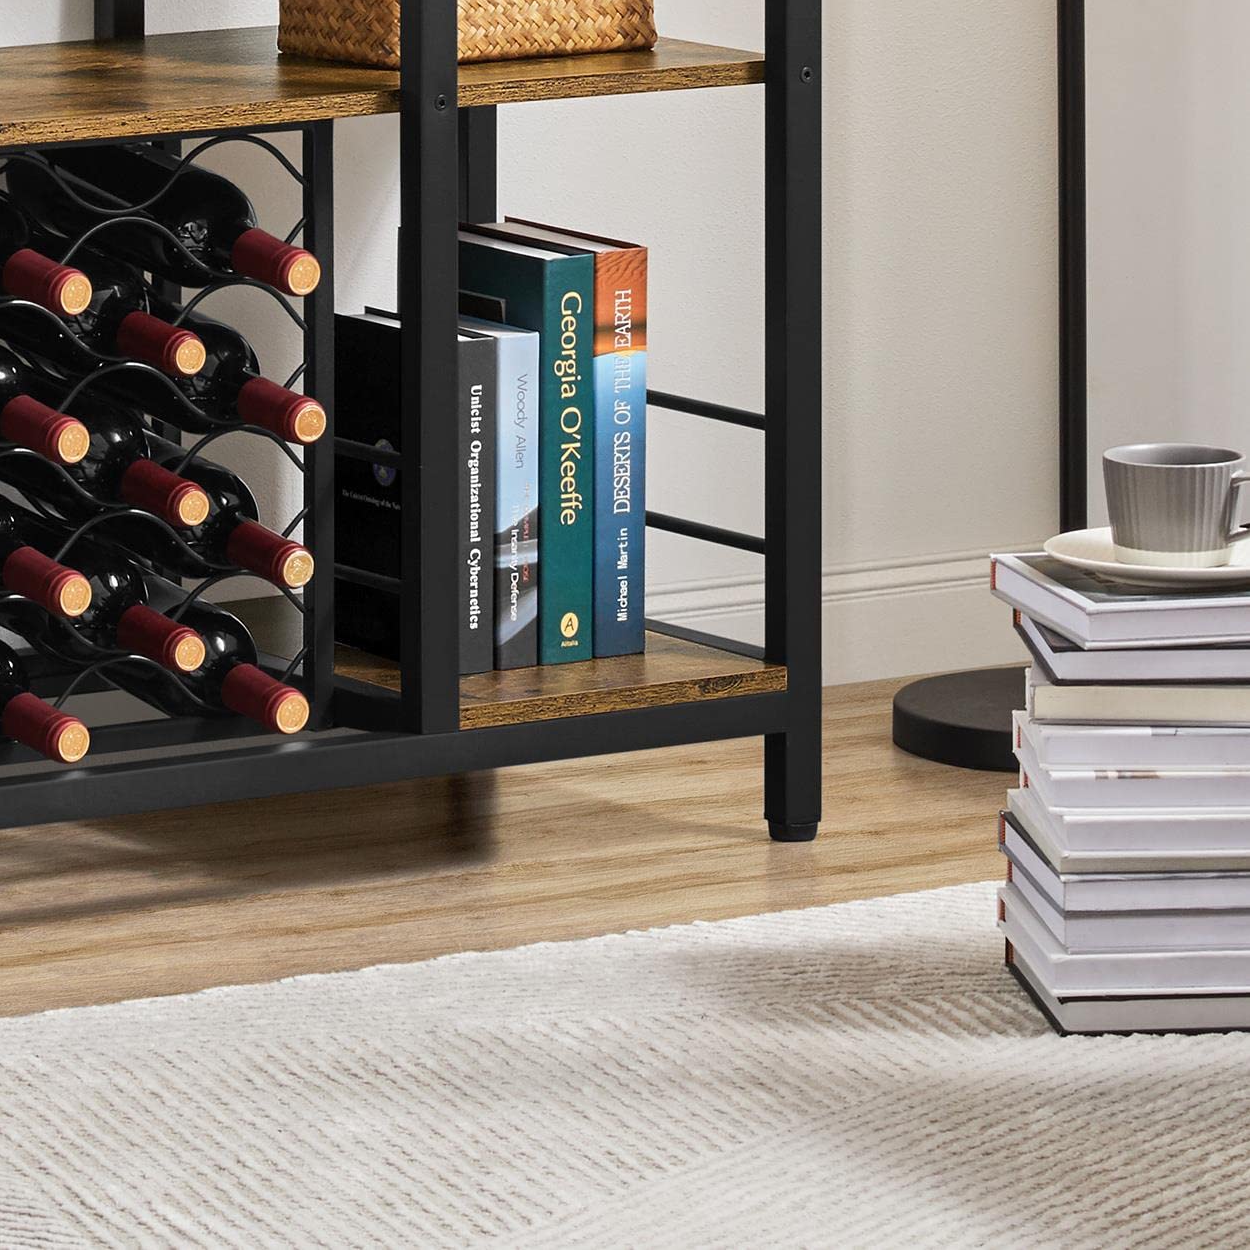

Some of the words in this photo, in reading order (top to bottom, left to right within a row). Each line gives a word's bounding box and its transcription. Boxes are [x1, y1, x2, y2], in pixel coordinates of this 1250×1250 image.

[614, 289, 632, 349] EARTH
[553, 291, 582, 399] Georgia
[614, 356, 632, 394] THE
[470, 383, 483, 435] Unicist
[514, 373, 528, 429] Woody
[614, 398, 631, 426] OF
[515, 435, 527, 469] Allen
[613, 430, 632, 514] DESERTS
[467, 439, 483, 543] Organizational
[508, 529, 520, 571] Insanity
[616, 527, 629, 570] Martin
[467, 548, 481, 631] Cybernetics
[510, 573, 520, 621] Defense
[616, 572, 629, 622] Michael
